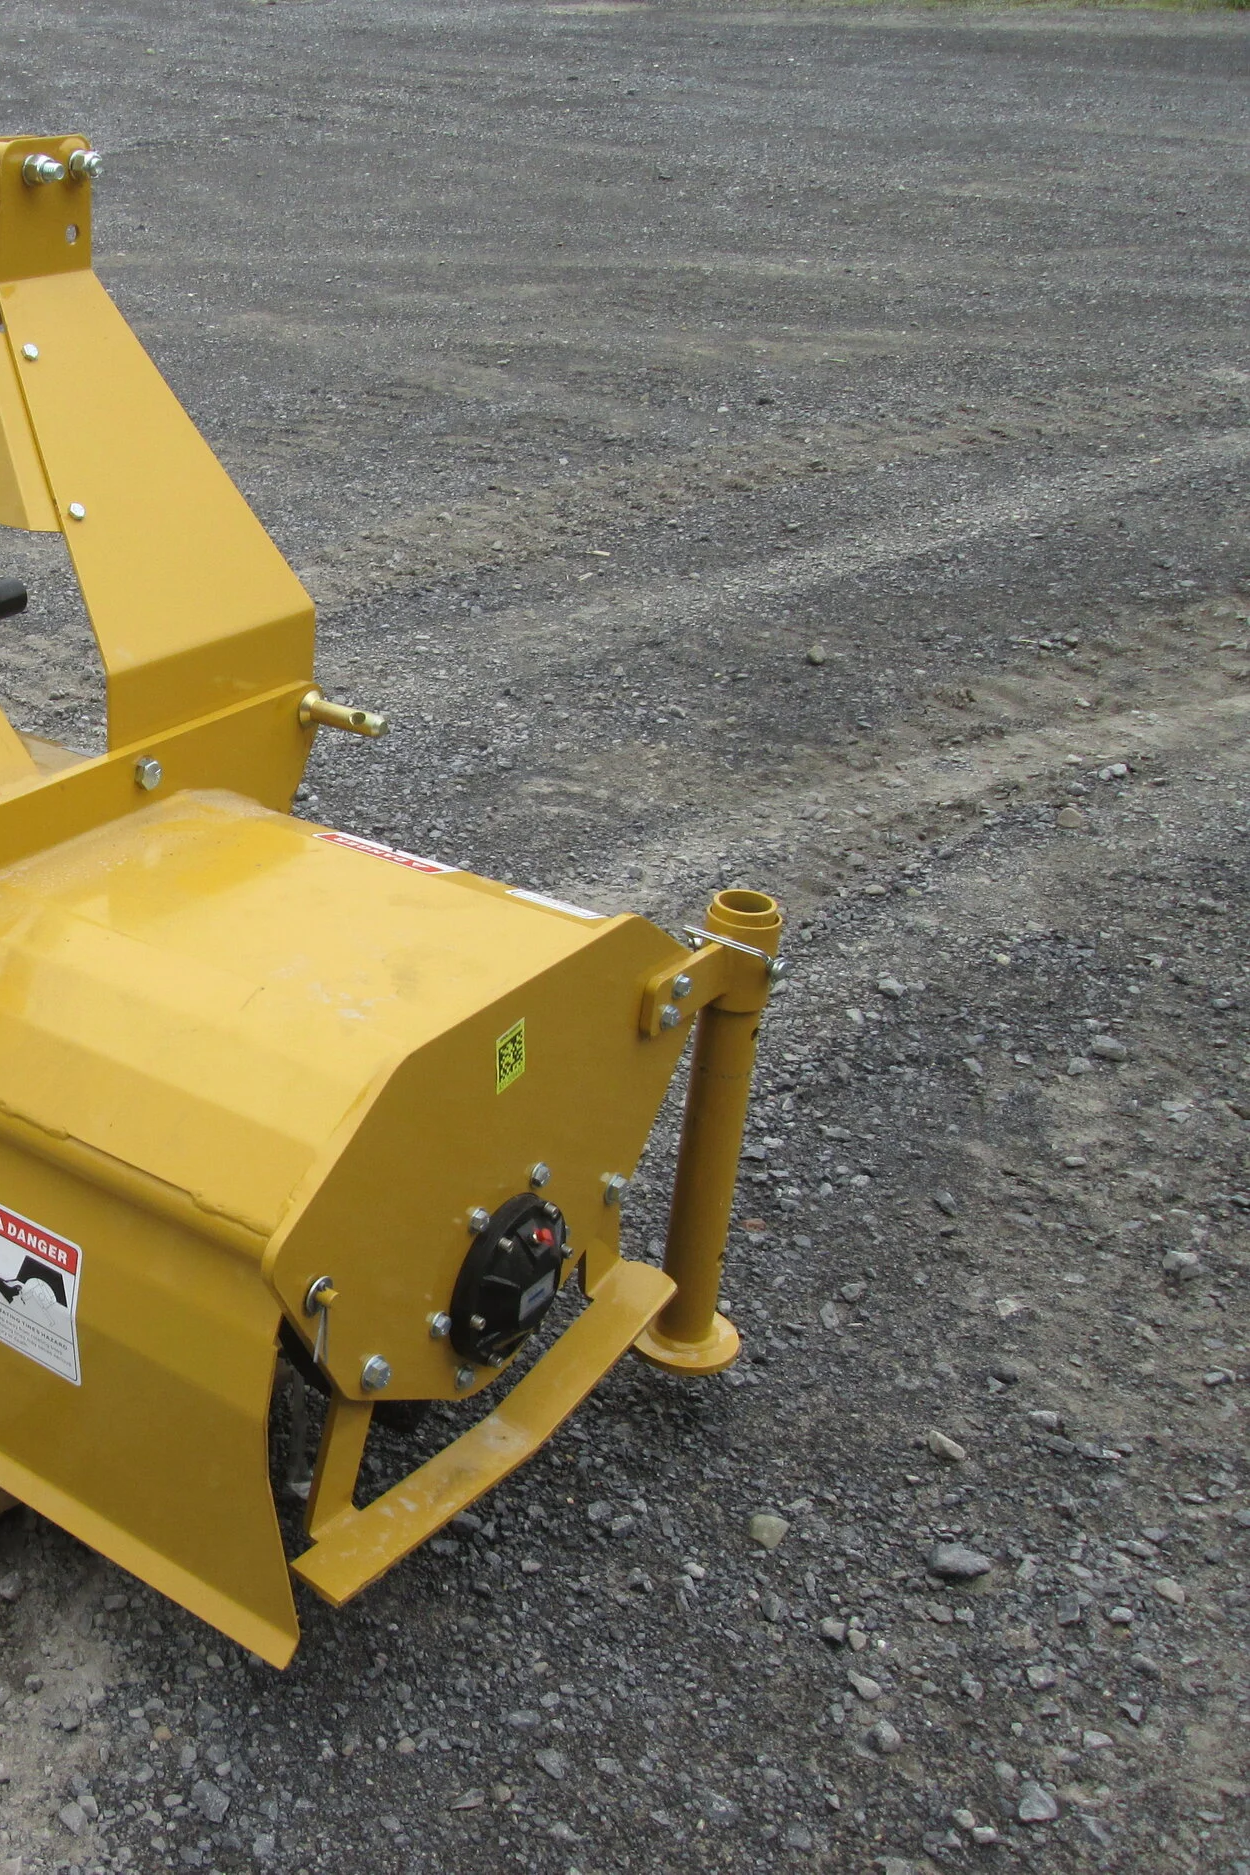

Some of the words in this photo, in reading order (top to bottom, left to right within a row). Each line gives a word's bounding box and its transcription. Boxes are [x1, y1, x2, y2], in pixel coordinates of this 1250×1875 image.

[332, 836, 410, 863] DANGER
[7, 1222, 68, 1265] DANGER
[41, 1333, 68, 1350] HAZARD
